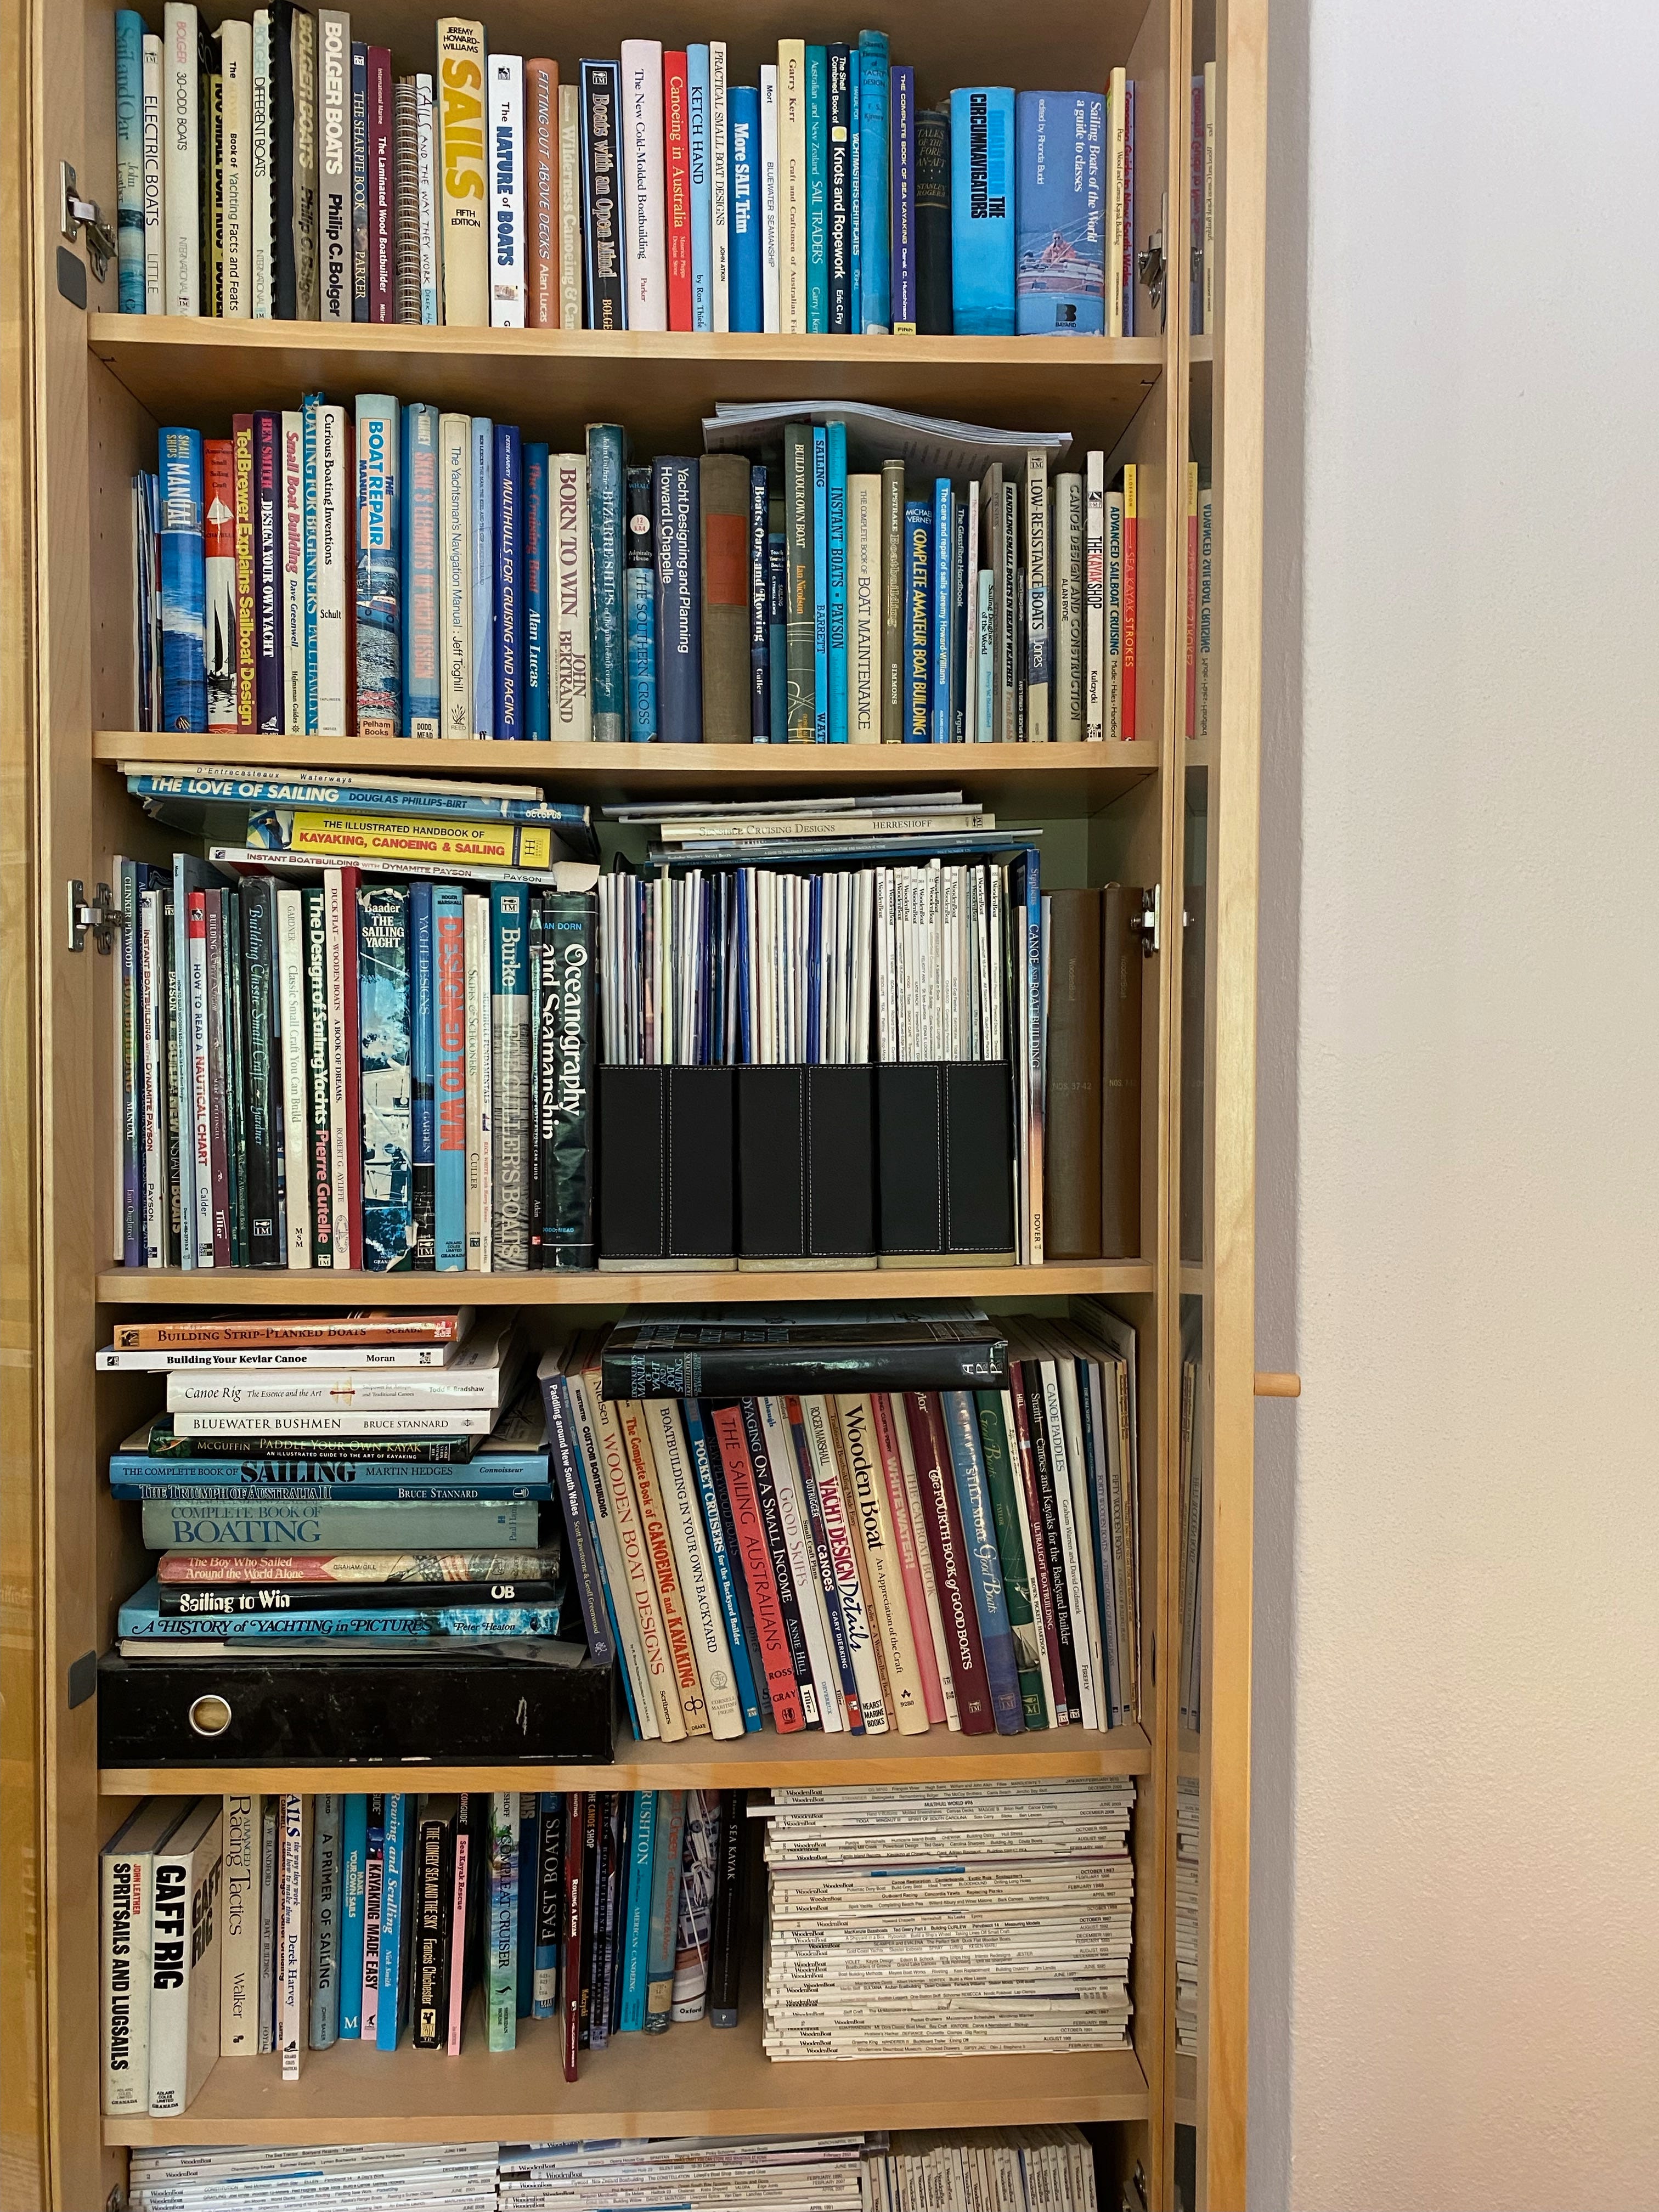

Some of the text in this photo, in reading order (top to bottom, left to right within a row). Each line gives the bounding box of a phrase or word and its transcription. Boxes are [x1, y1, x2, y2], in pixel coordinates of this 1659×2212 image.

[443, 35, 480, 44] HOWARD-
[447, 27, 473, 36] JEREMY
[443, 43, 478, 53] WILLIAMS
[176, 21, 187, 151] BOLGER 30-ODD BOATS
[442, 58, 484, 200] SAILS
[692, 86, 704, 184] KETCH HAND
[1074, 109, 1085, 139] guide
[144, 95, 159, 226] ELECTRIC BOATS
[970, 93, 988, 219] CIRCUMNAVIGATORS
[1076, 141, 1085, 152] to
[230, 157, 238, 168] of
[325, 21, 343, 317] BOLGER BOATS Philip C. Bolger
[1074, 154, 1084, 193] classes
[1087, 101, 1102, 242] Sailing Boats of the World
[228, 173, 239, 220] Yachting
[989, 196, 1006, 218] THE
[451, 218, 481, 228] EDITION
[456, 209, 475, 217] FIFTH
[229, 223, 239, 253] Facts
[229, 257, 239, 279] and
[229, 281, 239, 311] Feats
[359, 460, 367, 509] MANUAL
[369, 421, 384, 546] BOAT REPAIR
[385, 476, 394, 495] THE
[560, 467, 578, 618] BORN TO WIN
[236, 428, 255, 726] Ted Brewer Explains Sailboat Design
[831, 487, 844, 648] INSTANT BOATS PAYSON
[320, 609, 341, 619] Schult
[502, 478, 515, 725] MULTIHULLS FOR CRUISING AND RACING
[913, 528, 927, 735] COMPLETE AMATEUR BOAT BUILDING
[859, 577, 871, 730] BOAT MAINTENANCE
[559, 630, 573, 723] BERTRAND
[573, 653, 586, 698] JOHN
[151, 777, 467, 809] THE LOVE OF SAILING DOUGLAS PHILLIPS-BIRT
[324, 820, 485, 838] THE ILLUSTRATED HANDBOOK OF
[873, 820, 932, 830] HERRESHOFF
[300, 832, 505, 856] KAYAKING, CANOEING & SAILING
[504, 873, 541, 883] PAYSON
[362, 927, 404, 938] SAILING
[371, 916, 394, 927] THE
[366, 938, 400, 948] YACHT
[502, 927, 521, 987] Burke
[541, 943, 560, 1139] and Seamanship
[558, 943, 588, 1117] Oceanography
[195, 1056, 208, 1166] NAUTICAL CHART
[200, 1187, 208, 1216] Calder
[315, 1130, 331, 1244] Pierre Gutelle
[167, 1353, 395, 1365] Building Your Kevlar Canoe Moran
[185, 1385, 241, 1402] Canoe Rig
[193, 1418, 448, 1429] BLUEWATER BUSHMEN BRUCE STANNARD
[241, 1460, 356, 1483] SAILING
[366, 1466, 409, 1476] MARTIN
[411, 1467, 453, 1476] HEDGES
[845, 1403, 883, 1551] Wooden Boat
[173, 1520, 321, 1543] BOATING
[603, 1432, 633, 1523] WOODEN
[622, 1529, 646, 1582] BOAT
[635, 1589, 665, 1675] DESIGNS
[659, 1690, 672, 1725] Scribners
[180, 1590, 290, 1613] Sailing to Win
[453, 1622, 515, 1631] Peter Heaton
[862, 1700, 882, 1710] HEARST
[865, 1709, 884, 1719] MARINE
[867, 1718, 885, 1728] BOOKS
[226, 1796, 251, 1936] Racing Tactics
[458, 1855, 467, 1881] Kayak
[542, 1819, 560, 1940] FAST BOATS
[132, 1864, 141, 1915] JOHN LEATHER
[456, 1883, 466, 1910] Rescue
[154, 1865, 187, 1989] GAFF RIG
[365, 1863, 382, 1990] KAYAKING MADE EASY
[111, 1863, 131, 2070] SPRITSAILS AND LUGSAILS
[233, 1973, 246, 2018] Walker
[680, 2006, 702, 2015] Oxford
